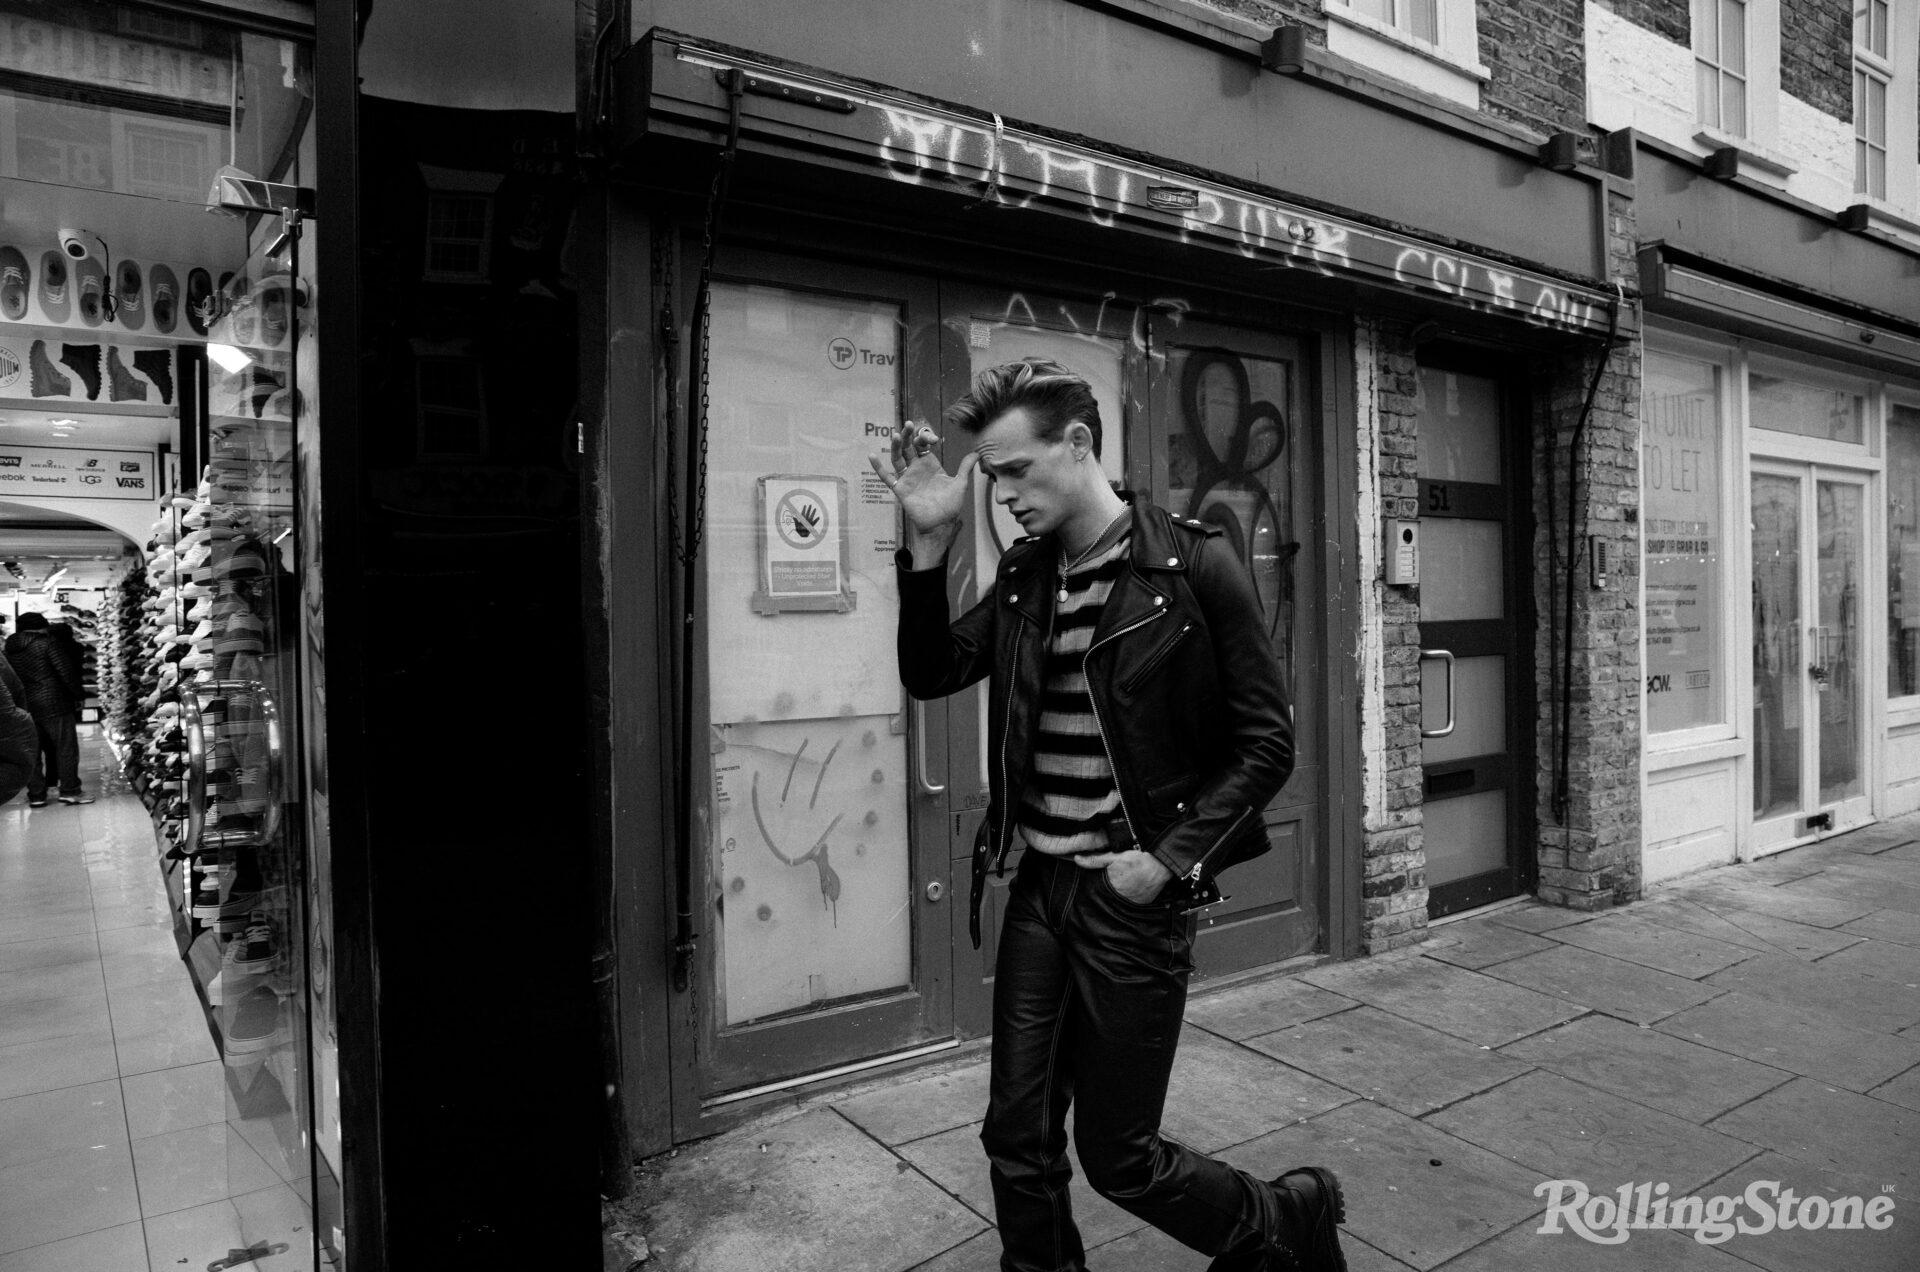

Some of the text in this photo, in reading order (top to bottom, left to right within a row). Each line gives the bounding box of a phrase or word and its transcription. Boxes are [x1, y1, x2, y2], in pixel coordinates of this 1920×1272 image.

[860, 348, 895, 366] Trav
[1664, 392, 1705, 440] UNIT
[1643, 444, 1702, 493] TO LET
[115, 477, 145, 488] VANS
[1429, 484, 1450, 511] 51
[1648, 539, 1665, 554] SHOP
